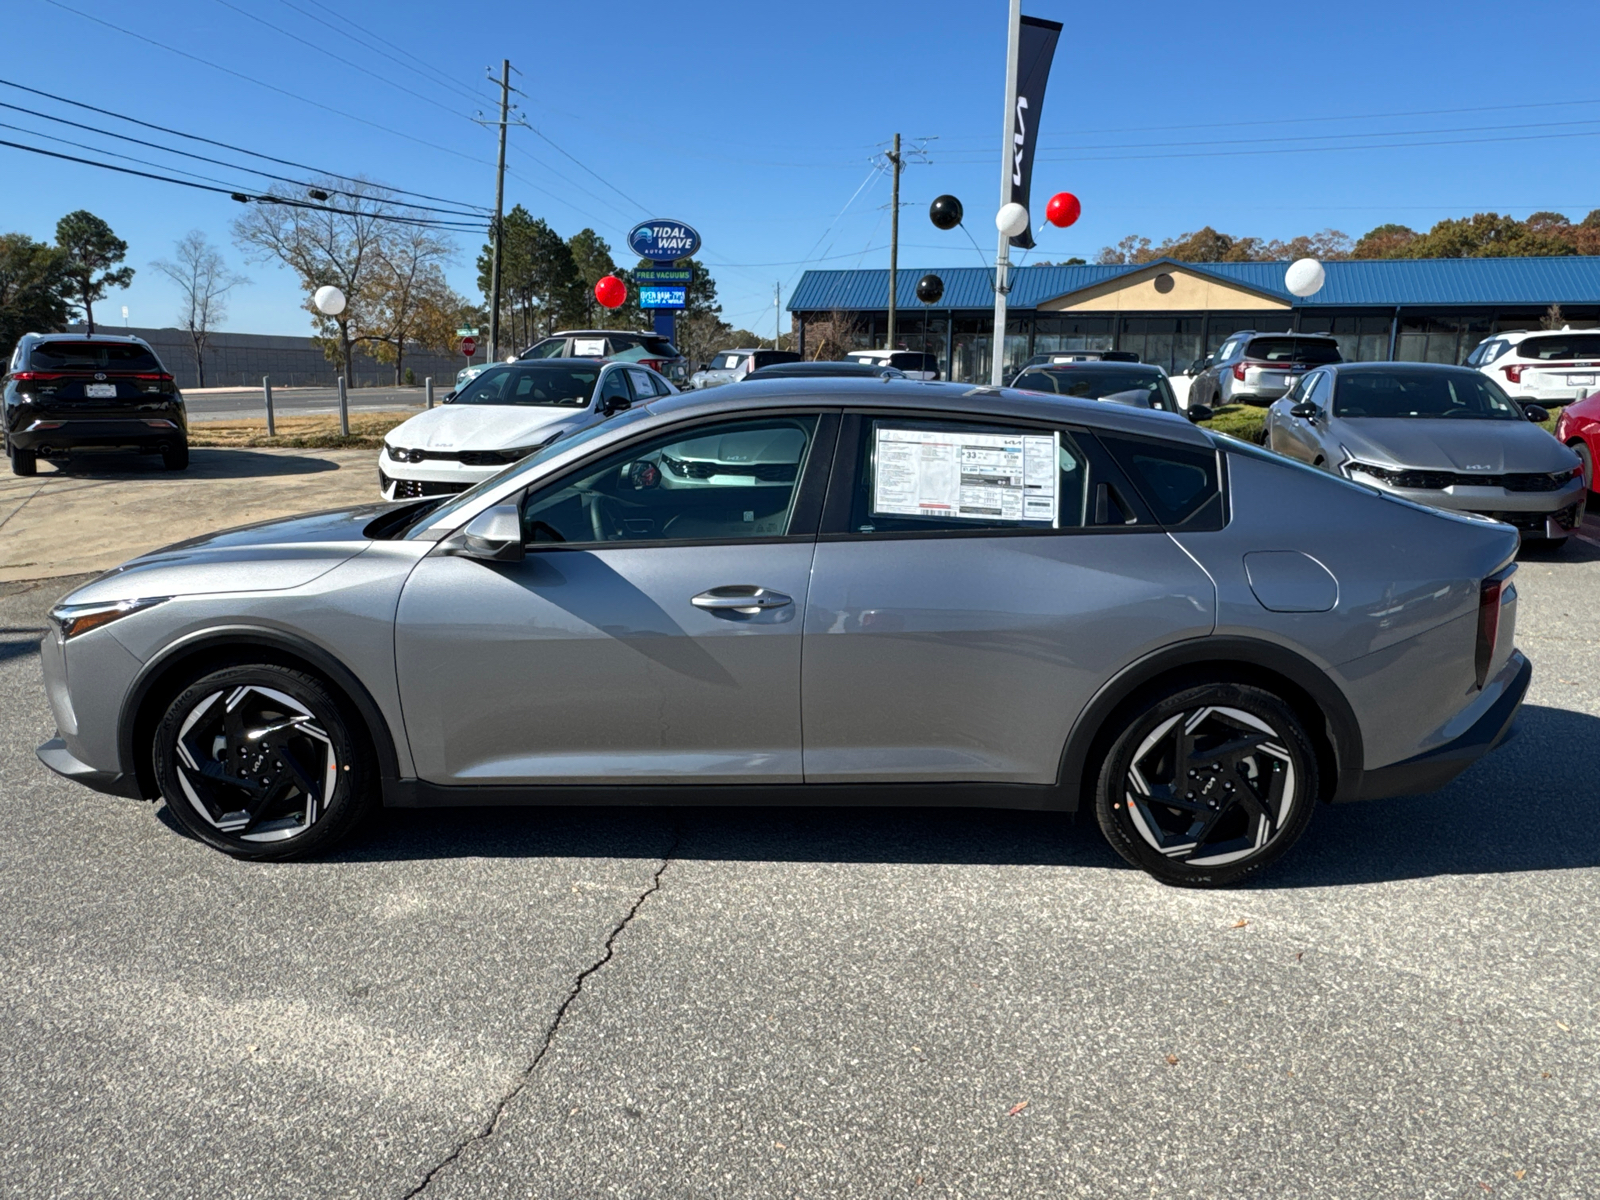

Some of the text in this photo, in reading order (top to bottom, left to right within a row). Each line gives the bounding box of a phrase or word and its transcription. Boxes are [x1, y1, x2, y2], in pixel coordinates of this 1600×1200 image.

[653, 227, 686, 238] TIDAL
[658, 238, 693, 249] WAVE
[636, 271, 690, 279] FREE VACUUMS
[462, 342, 476, 352] STOP
[163, 690, 193, 731] KUMHO
